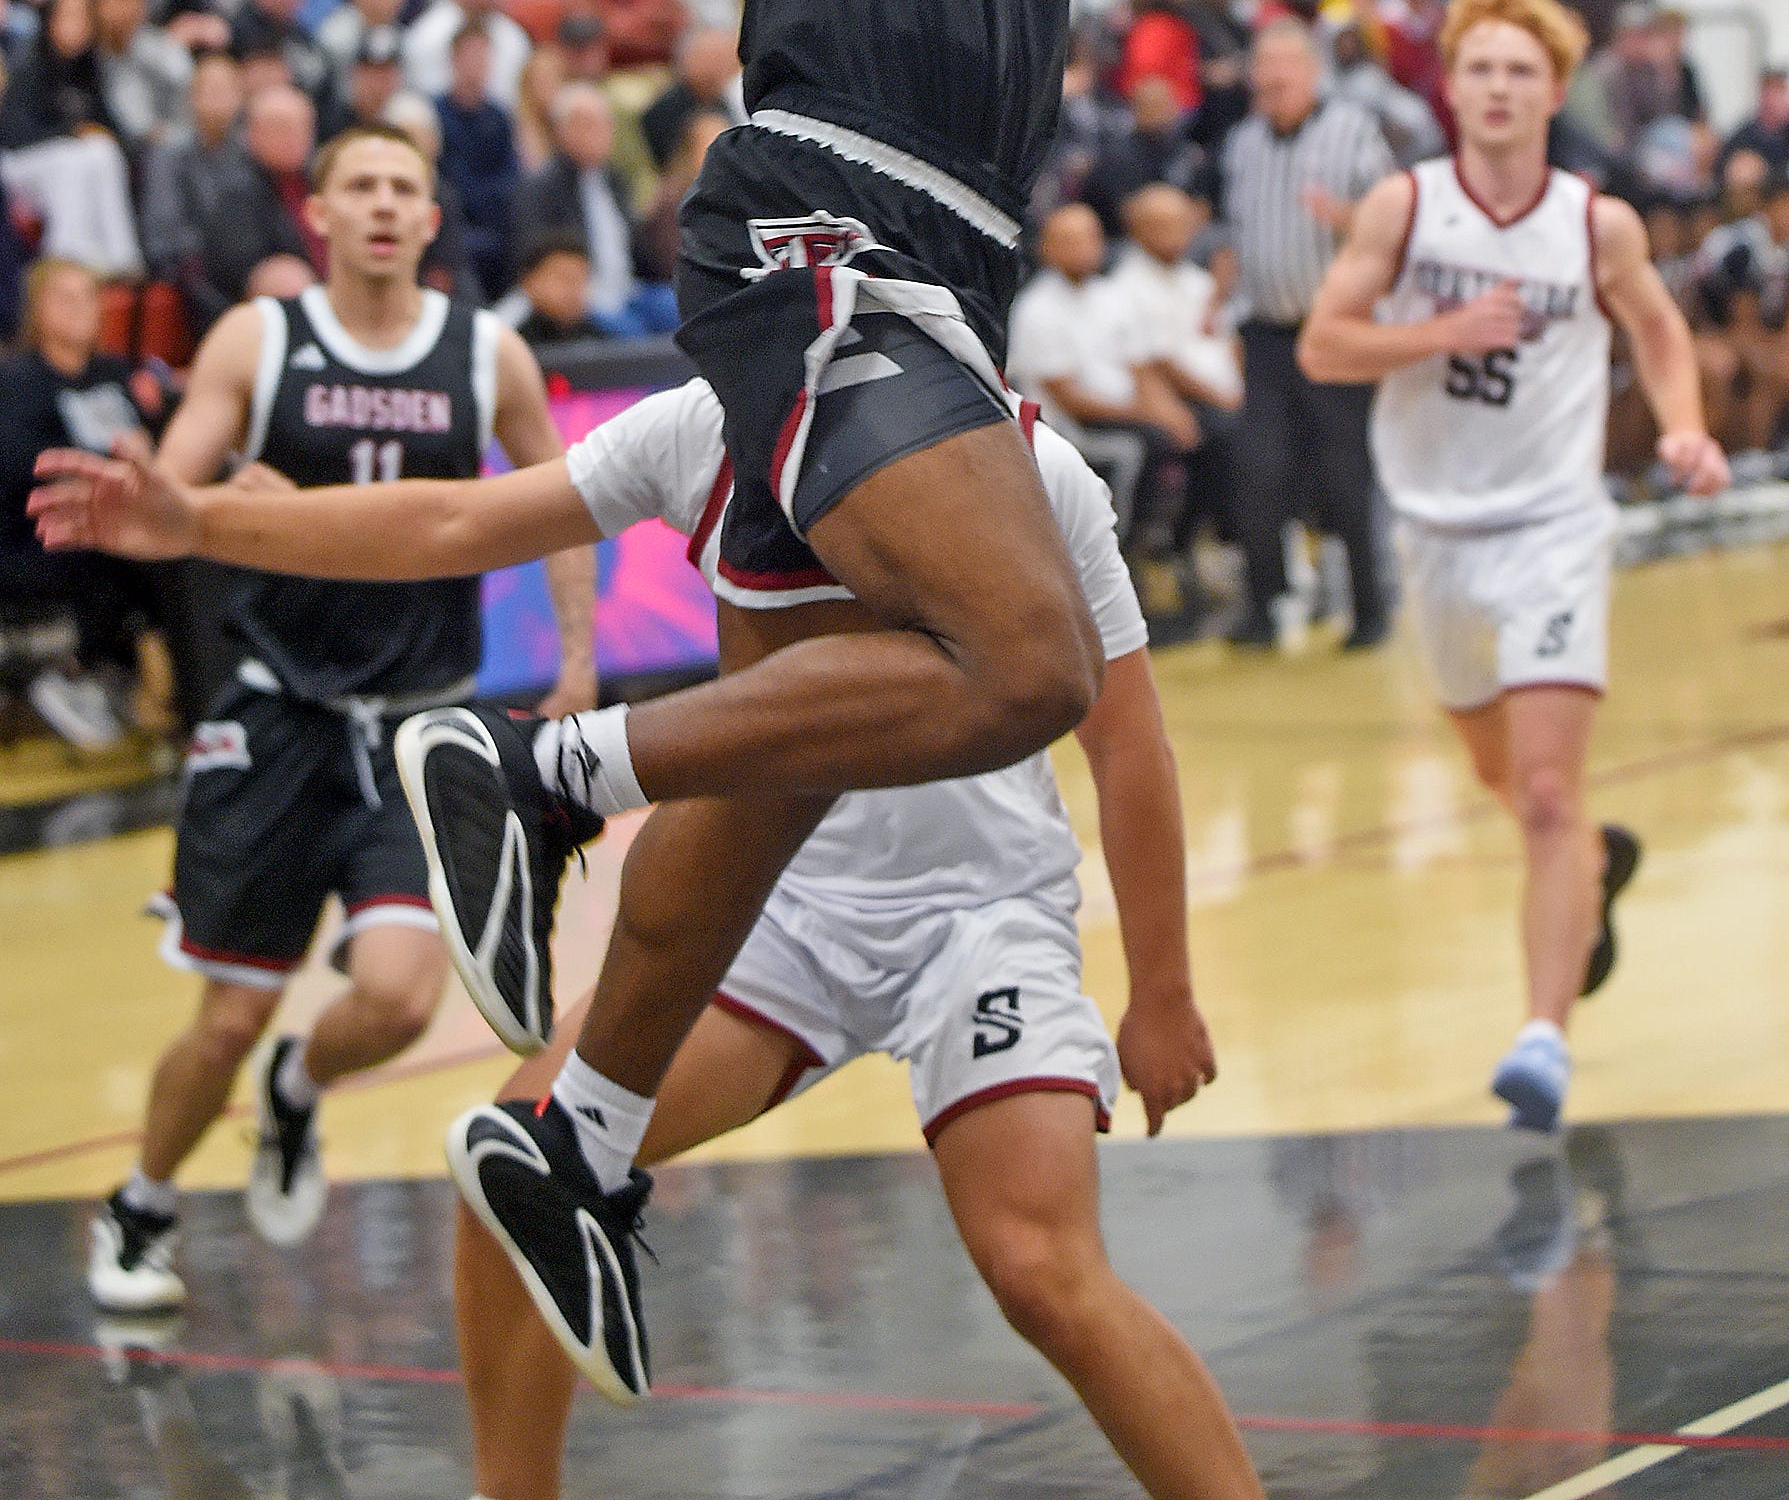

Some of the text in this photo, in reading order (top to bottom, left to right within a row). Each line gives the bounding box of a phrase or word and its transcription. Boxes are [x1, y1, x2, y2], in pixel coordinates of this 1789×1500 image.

[305, 383, 451, 434] GADSDEN
[1535, 608, 1575, 659] S
[972, 985, 1025, 1060] S
